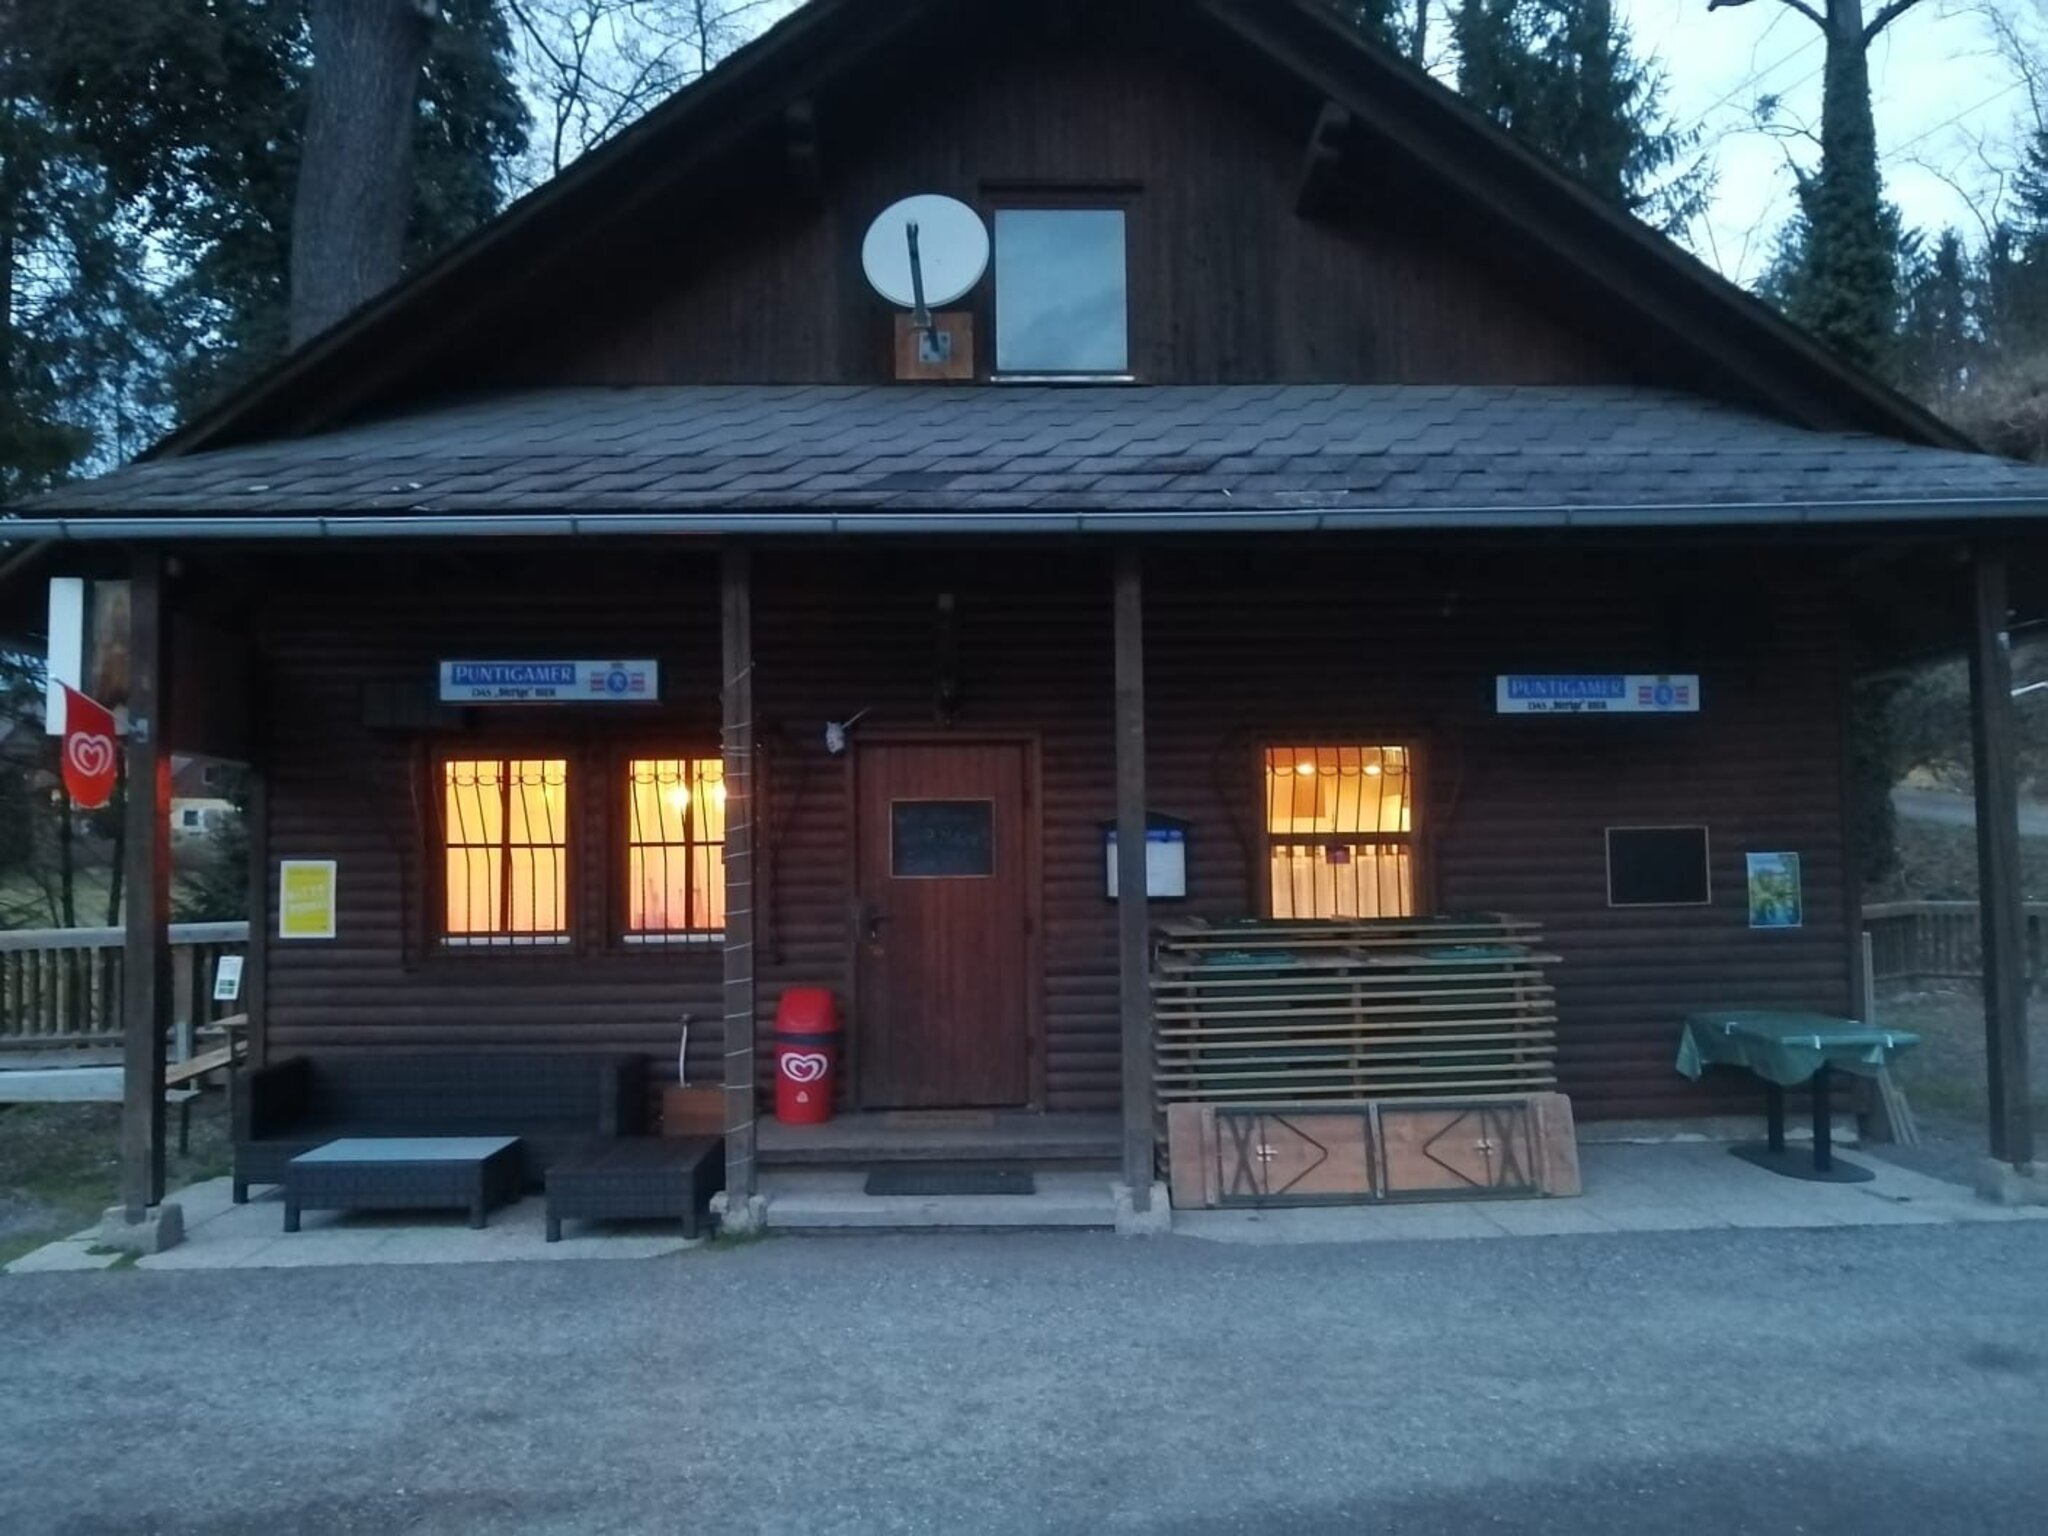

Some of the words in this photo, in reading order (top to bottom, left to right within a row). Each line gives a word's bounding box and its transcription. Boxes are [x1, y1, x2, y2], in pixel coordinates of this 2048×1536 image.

[455, 666, 572, 682] PUNTIGAMER
[472, 687, 492, 697] DAS
[1511, 680, 1624, 695] PUNTIGAMER
[1528, 701, 1547, 710] DAS
